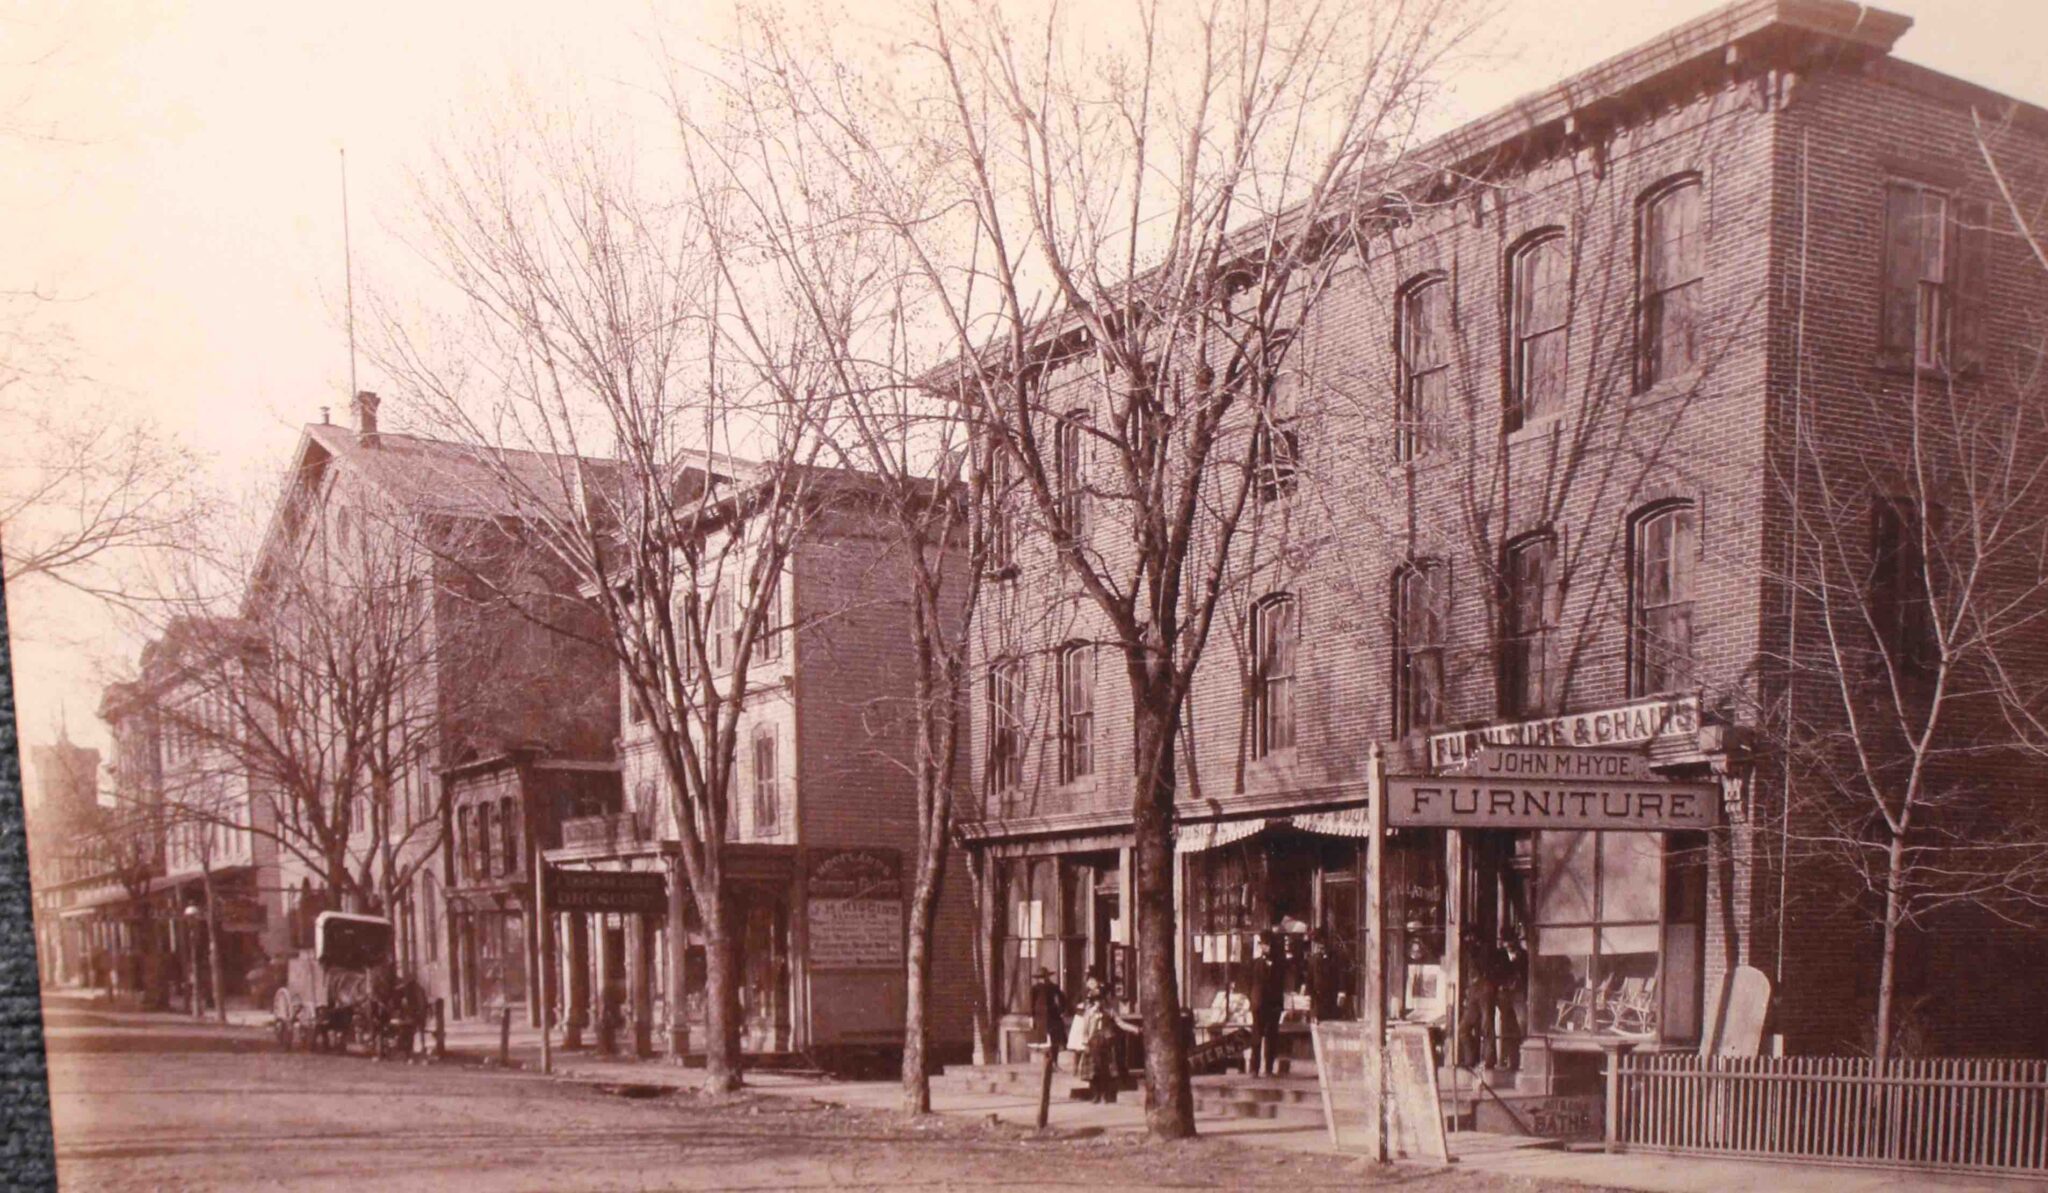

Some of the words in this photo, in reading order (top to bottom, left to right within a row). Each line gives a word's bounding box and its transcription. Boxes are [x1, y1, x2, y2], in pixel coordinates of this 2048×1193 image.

[1573, 717, 1591, 745] &
[1594, 704, 1695, 743] CHAIRS
[1488, 751, 1549, 773] JOHN
